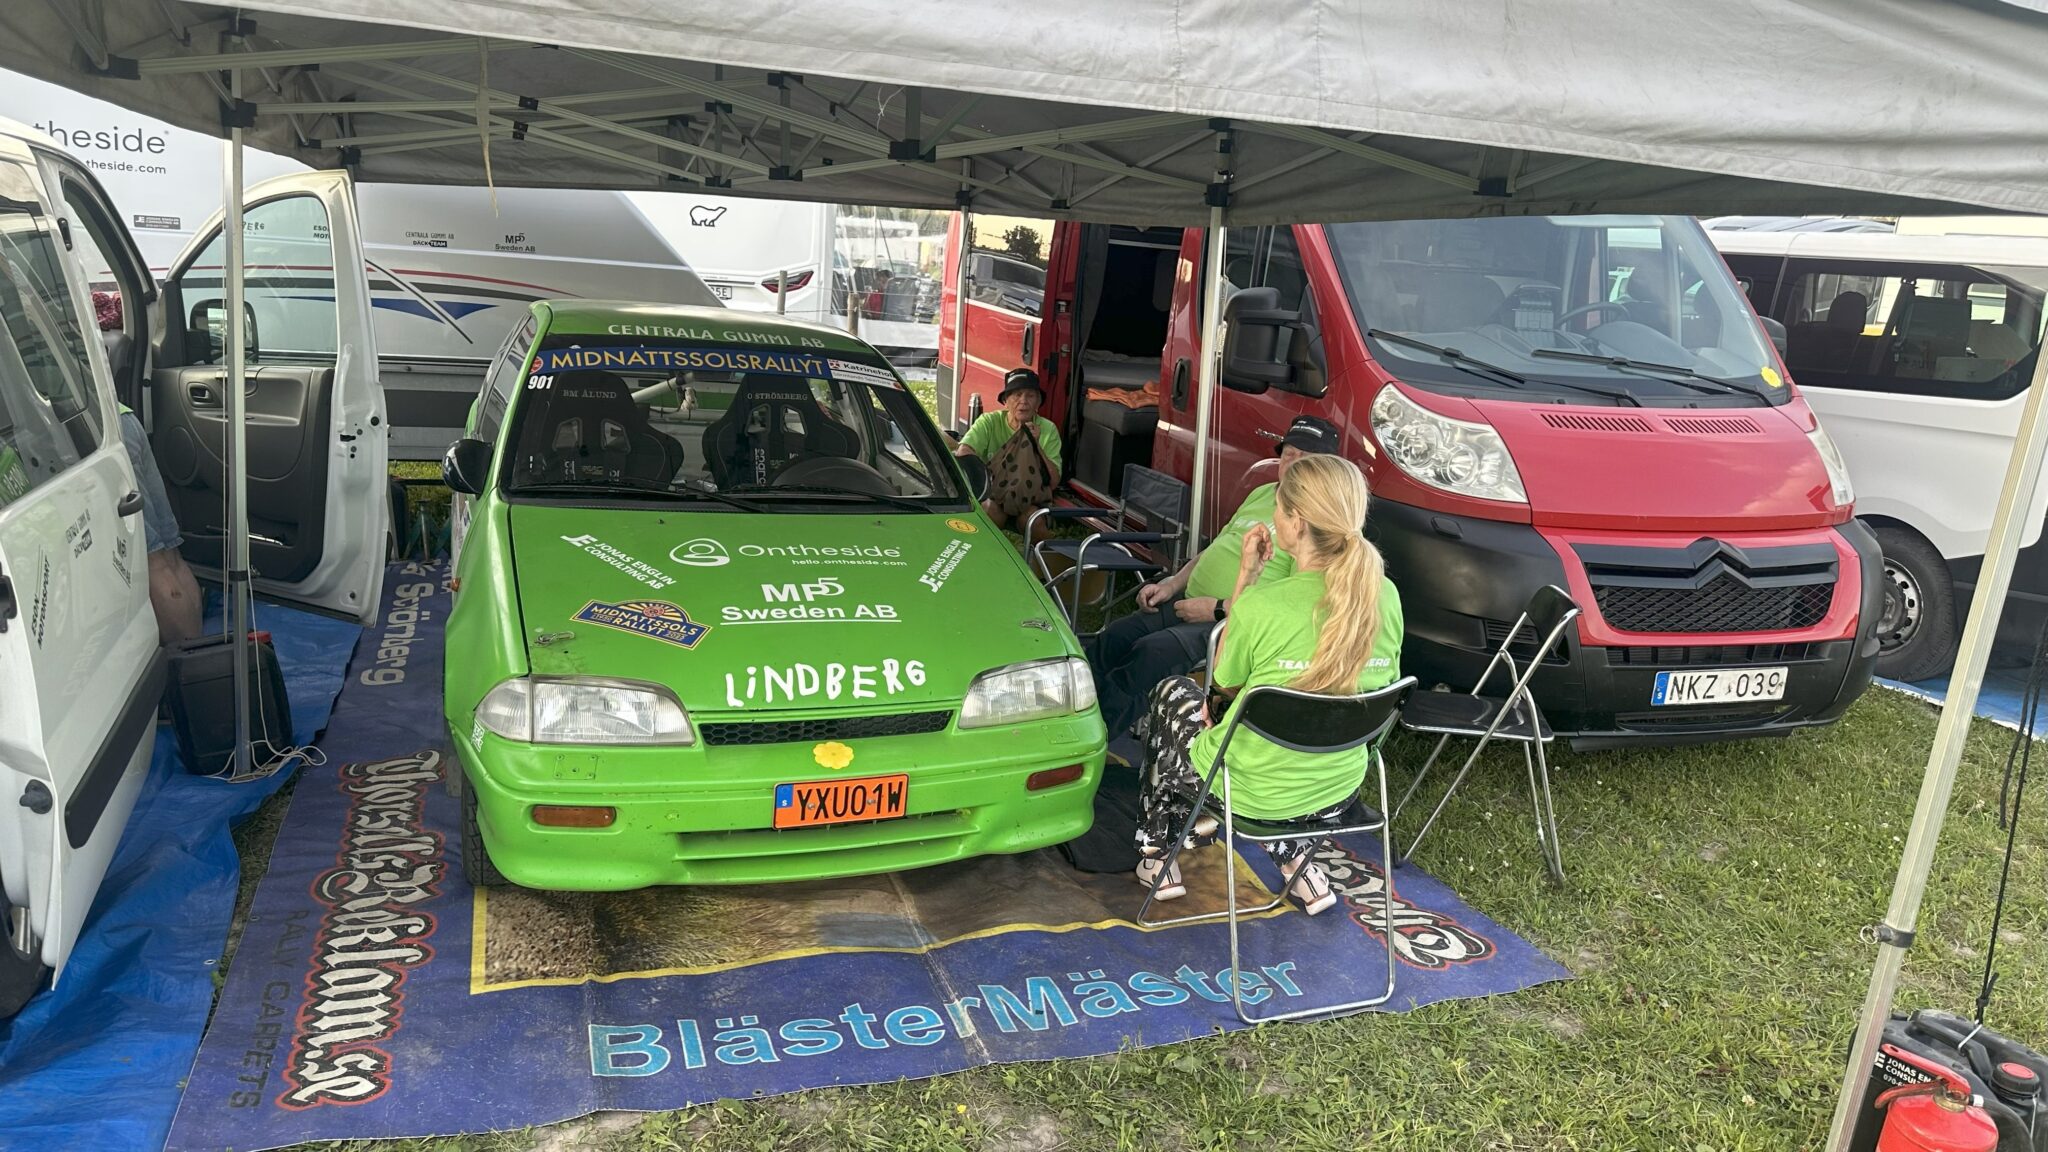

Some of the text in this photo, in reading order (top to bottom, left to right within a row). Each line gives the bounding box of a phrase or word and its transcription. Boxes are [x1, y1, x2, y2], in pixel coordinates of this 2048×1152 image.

[495, 243, 524, 251] Sweden
[607, 324, 825, 349] CENTRALA GUMMI AB
[551, 350, 823, 376] MIDNATTSSOLSRALLYT
[527, 375, 554, 390] 901
[595, 543, 677, 585] JONAS ENGLIN
[738, 544, 901, 558] Ontheside
[791, 559, 908, 567] hello.ontheside.com
[926, 538, 962, 576] JONAS ENGLIN
[937, 542, 973, 580] CONSULTING AB
[584, 546, 665, 590] CONSULTING AB
[591, 605, 699, 636] MIDNATTSSOLS
[721, 604, 898, 621] Sweden AB
[612, 618, 666, 635] RALLYT
[1669, 672, 1782, 701] NKZ 039
[275, 910, 310, 969] RALLY
[229, 981, 291, 1110] CARPETS
[1887, 1057, 1917, 1077] JONAS
